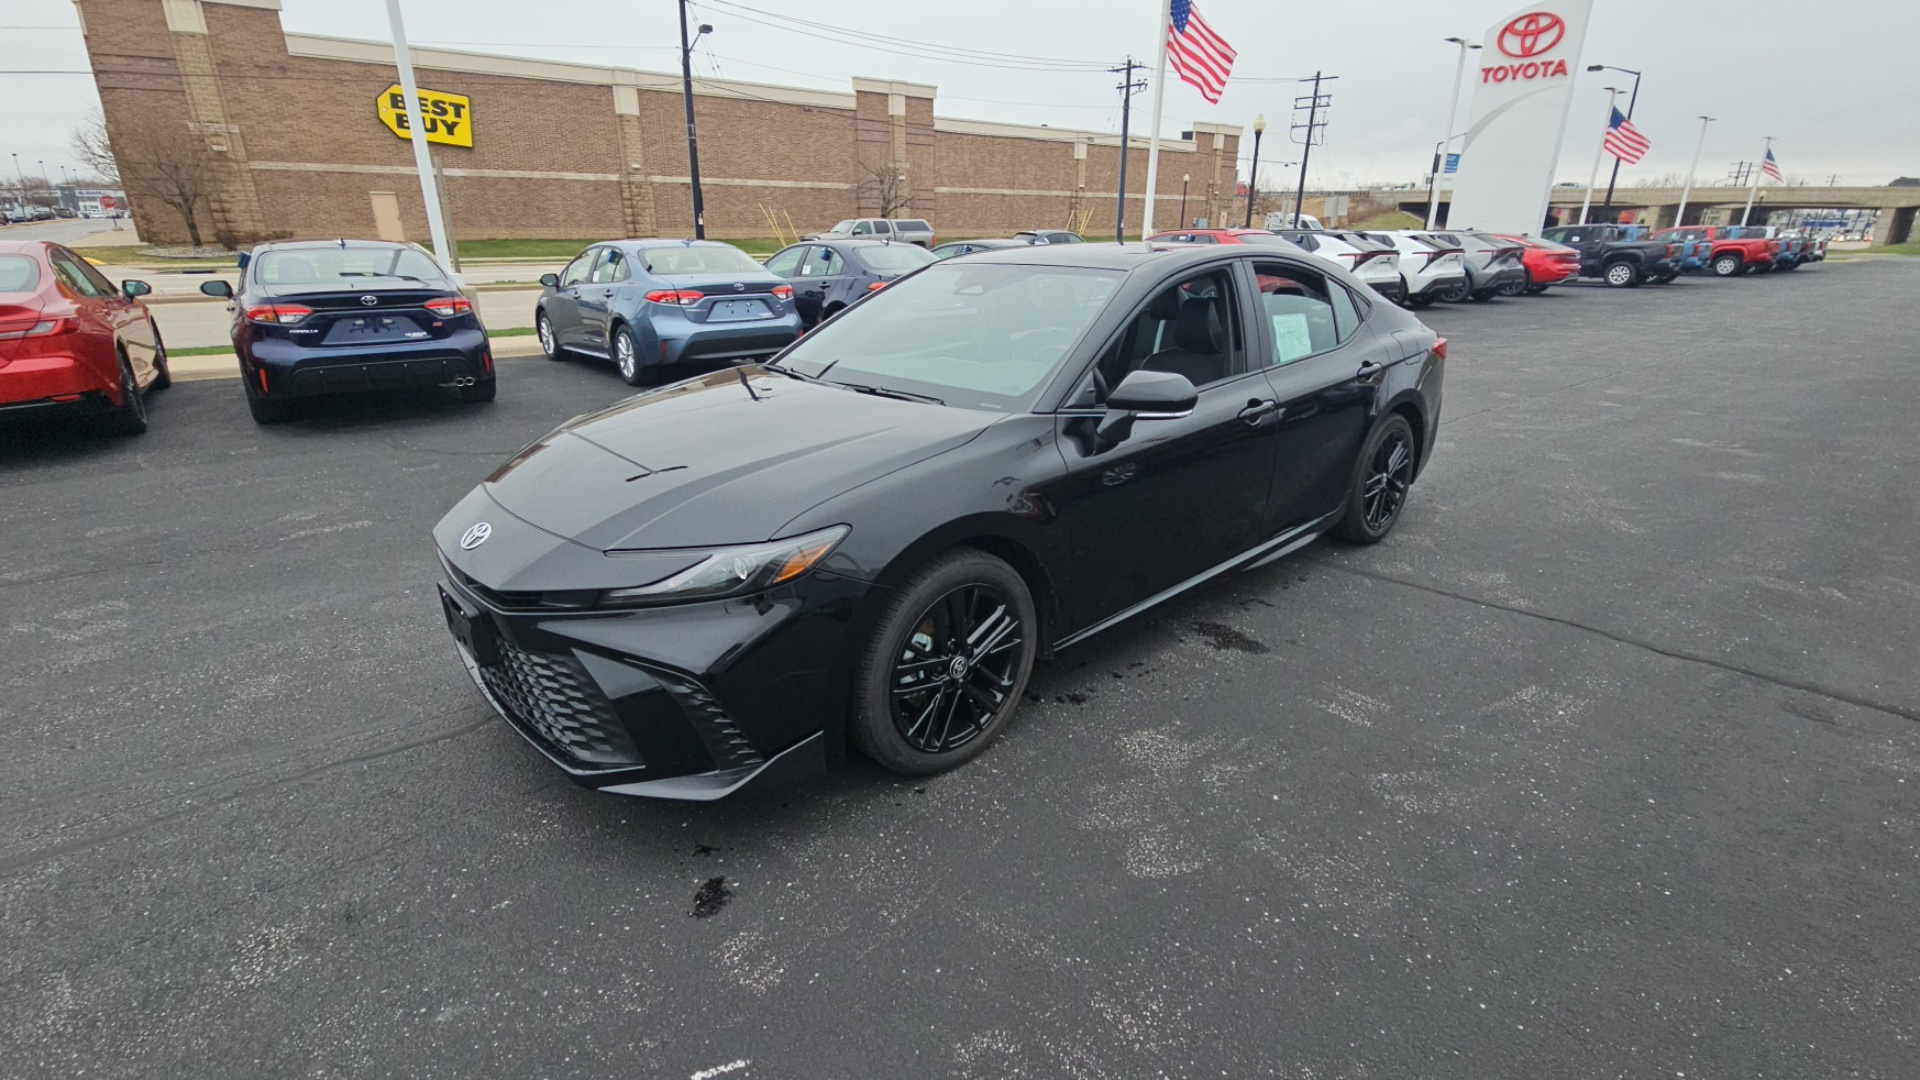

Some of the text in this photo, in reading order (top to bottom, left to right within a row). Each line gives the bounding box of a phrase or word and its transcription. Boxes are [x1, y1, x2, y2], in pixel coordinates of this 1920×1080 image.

[1481, 59, 1568, 84] TOYOTA
[389, 92, 466, 119] BEST
[395, 113, 460, 136] BUY
